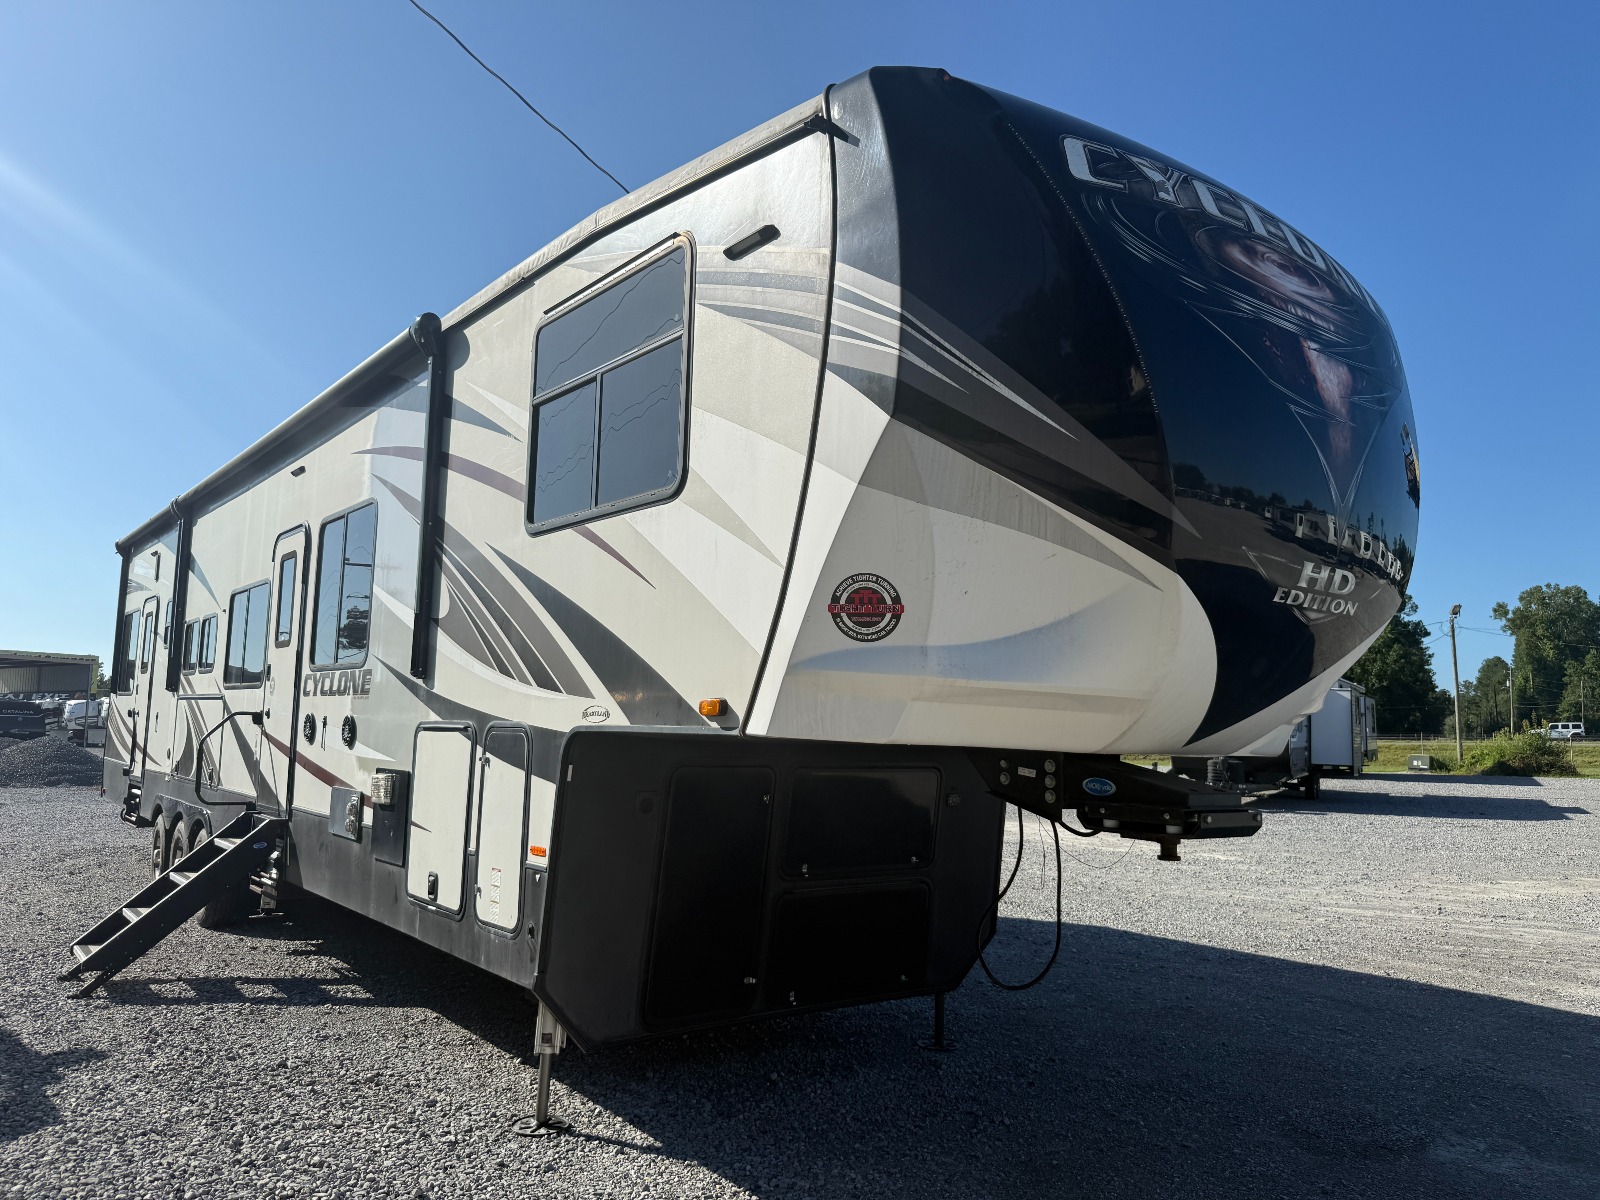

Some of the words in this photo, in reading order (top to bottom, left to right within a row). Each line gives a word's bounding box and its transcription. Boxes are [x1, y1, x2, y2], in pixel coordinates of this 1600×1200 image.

[835, 577, 854, 597] ACHIEVE
[1296, 560, 1357, 595] HD
[831, 604, 867, 613] TIGHT
[869, 604, 901, 613] TURN
[1272, 587, 1359, 617] EDITION
[302, 668, 373, 698] CYCLONE
